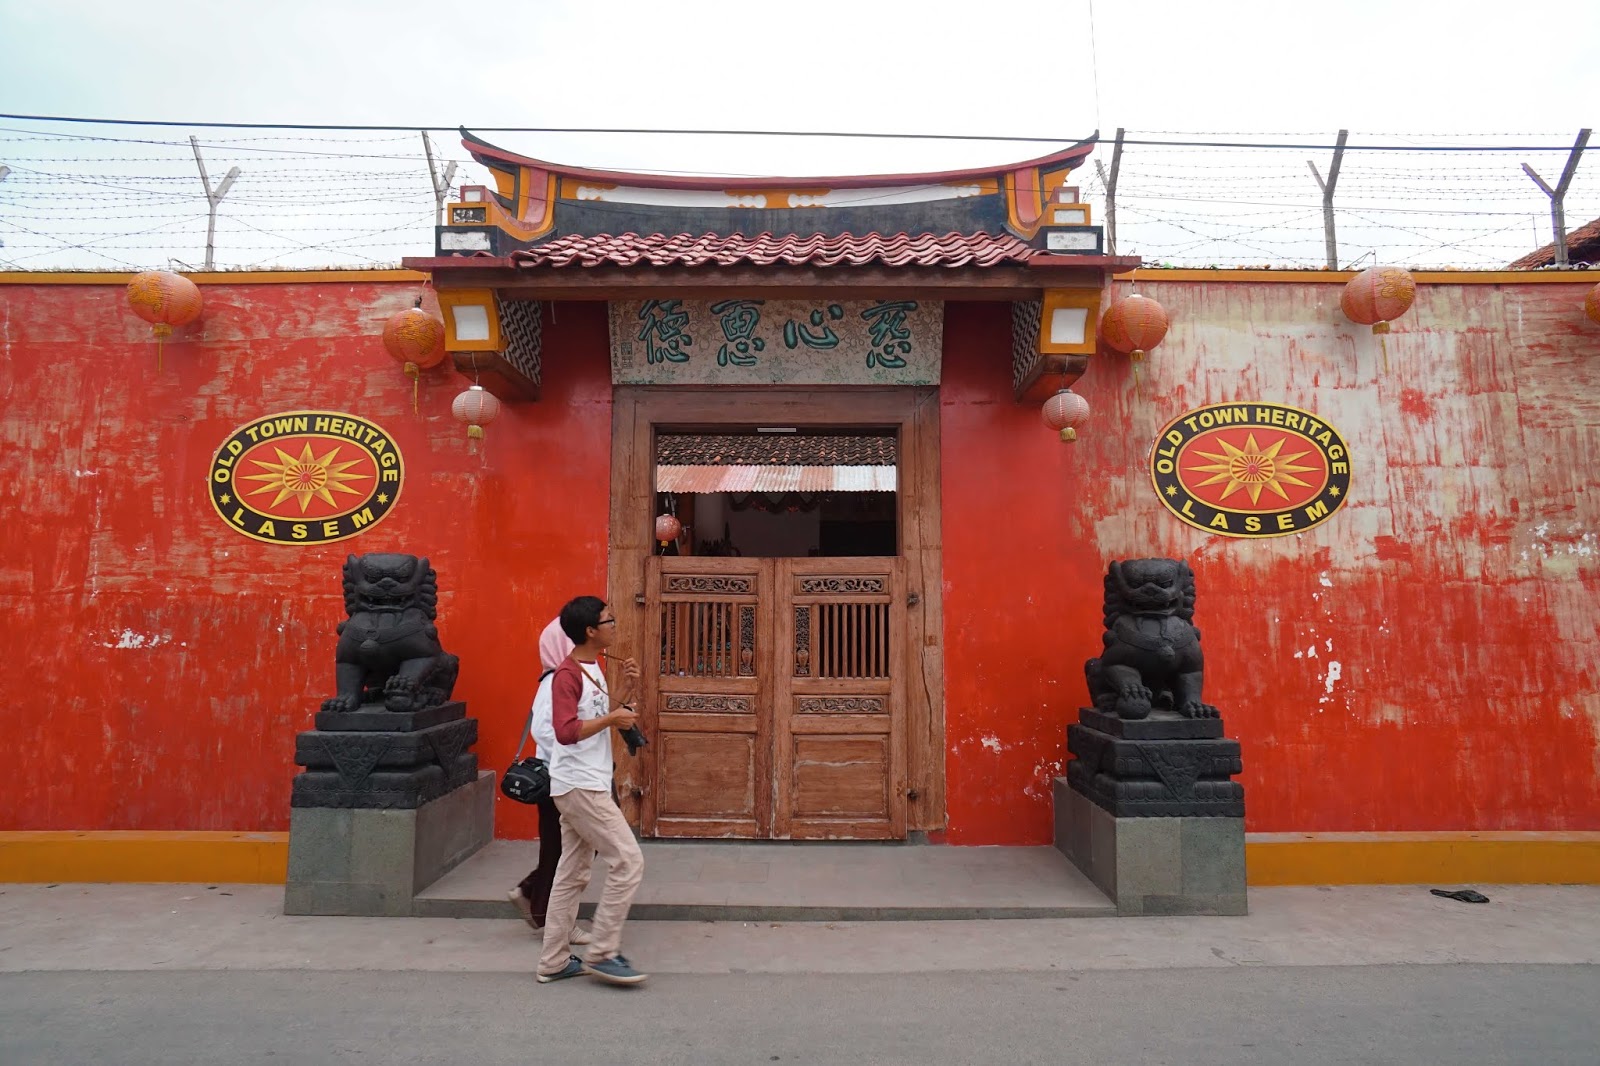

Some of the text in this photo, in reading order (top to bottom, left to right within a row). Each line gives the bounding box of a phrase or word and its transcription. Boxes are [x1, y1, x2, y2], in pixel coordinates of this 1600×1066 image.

[214, 417, 398, 483] OLD TOWN HERITAGE
[1157, 407, 1348, 475] OLD TOWN HERITAGE
[232, 507, 375, 539] LASEM
[1181, 500, 1329, 532] LASEM
